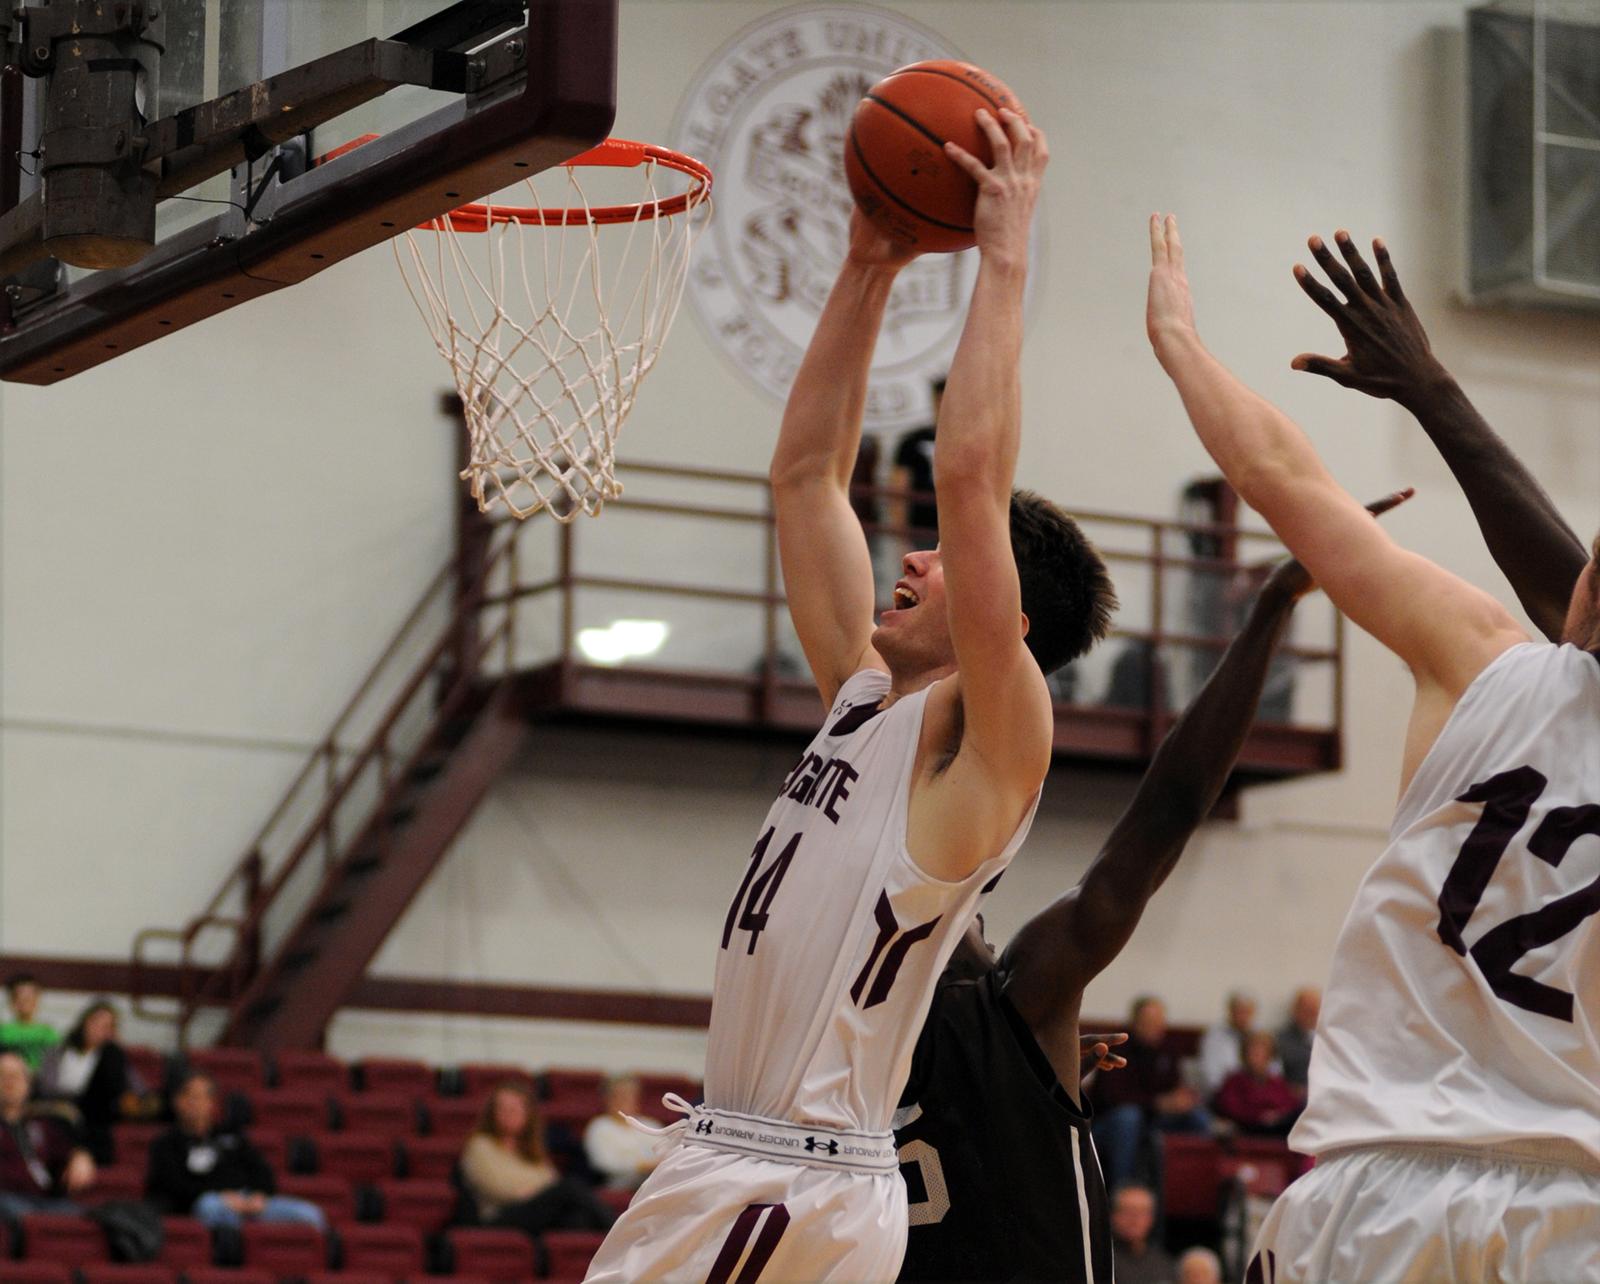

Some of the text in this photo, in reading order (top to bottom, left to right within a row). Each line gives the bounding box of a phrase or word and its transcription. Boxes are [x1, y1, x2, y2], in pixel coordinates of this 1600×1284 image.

[721, 826, 803, 955] 14
[1437, 765, 1600, 1024] 12
[715, 1126, 799, 1147] UNDER ARMOUR
